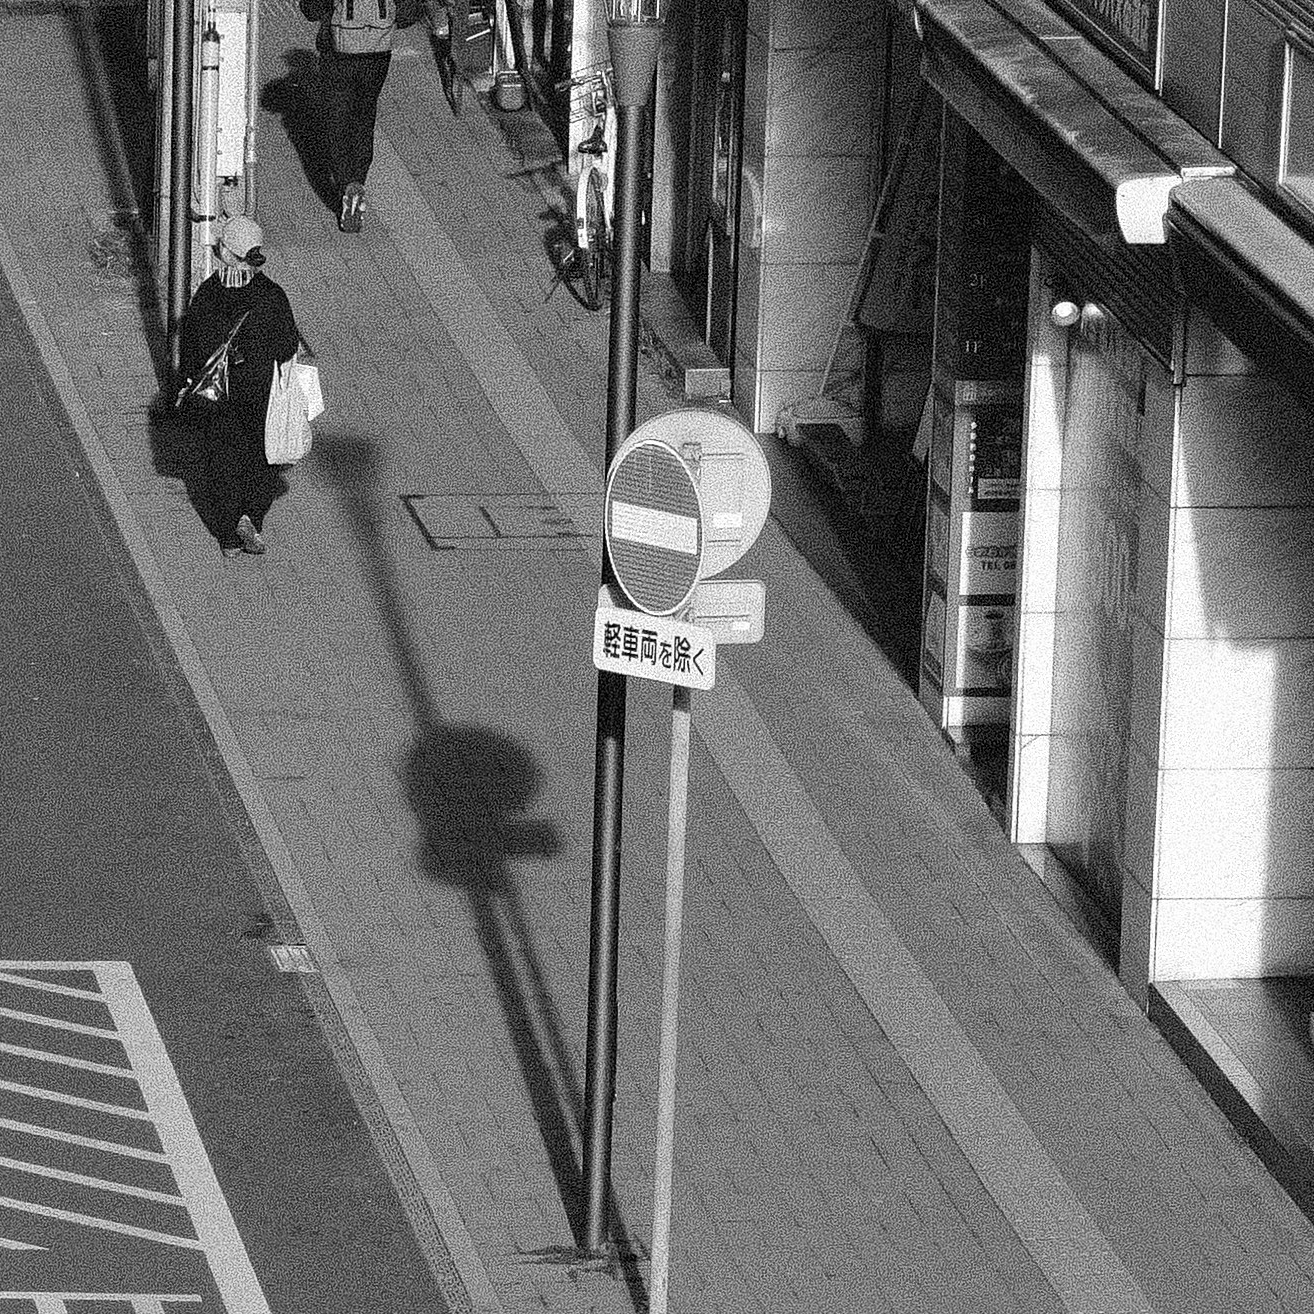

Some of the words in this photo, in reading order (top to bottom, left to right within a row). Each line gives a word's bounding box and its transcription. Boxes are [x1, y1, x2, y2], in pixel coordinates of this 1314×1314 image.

[603, 620, 705, 677] 軽車両を除く
